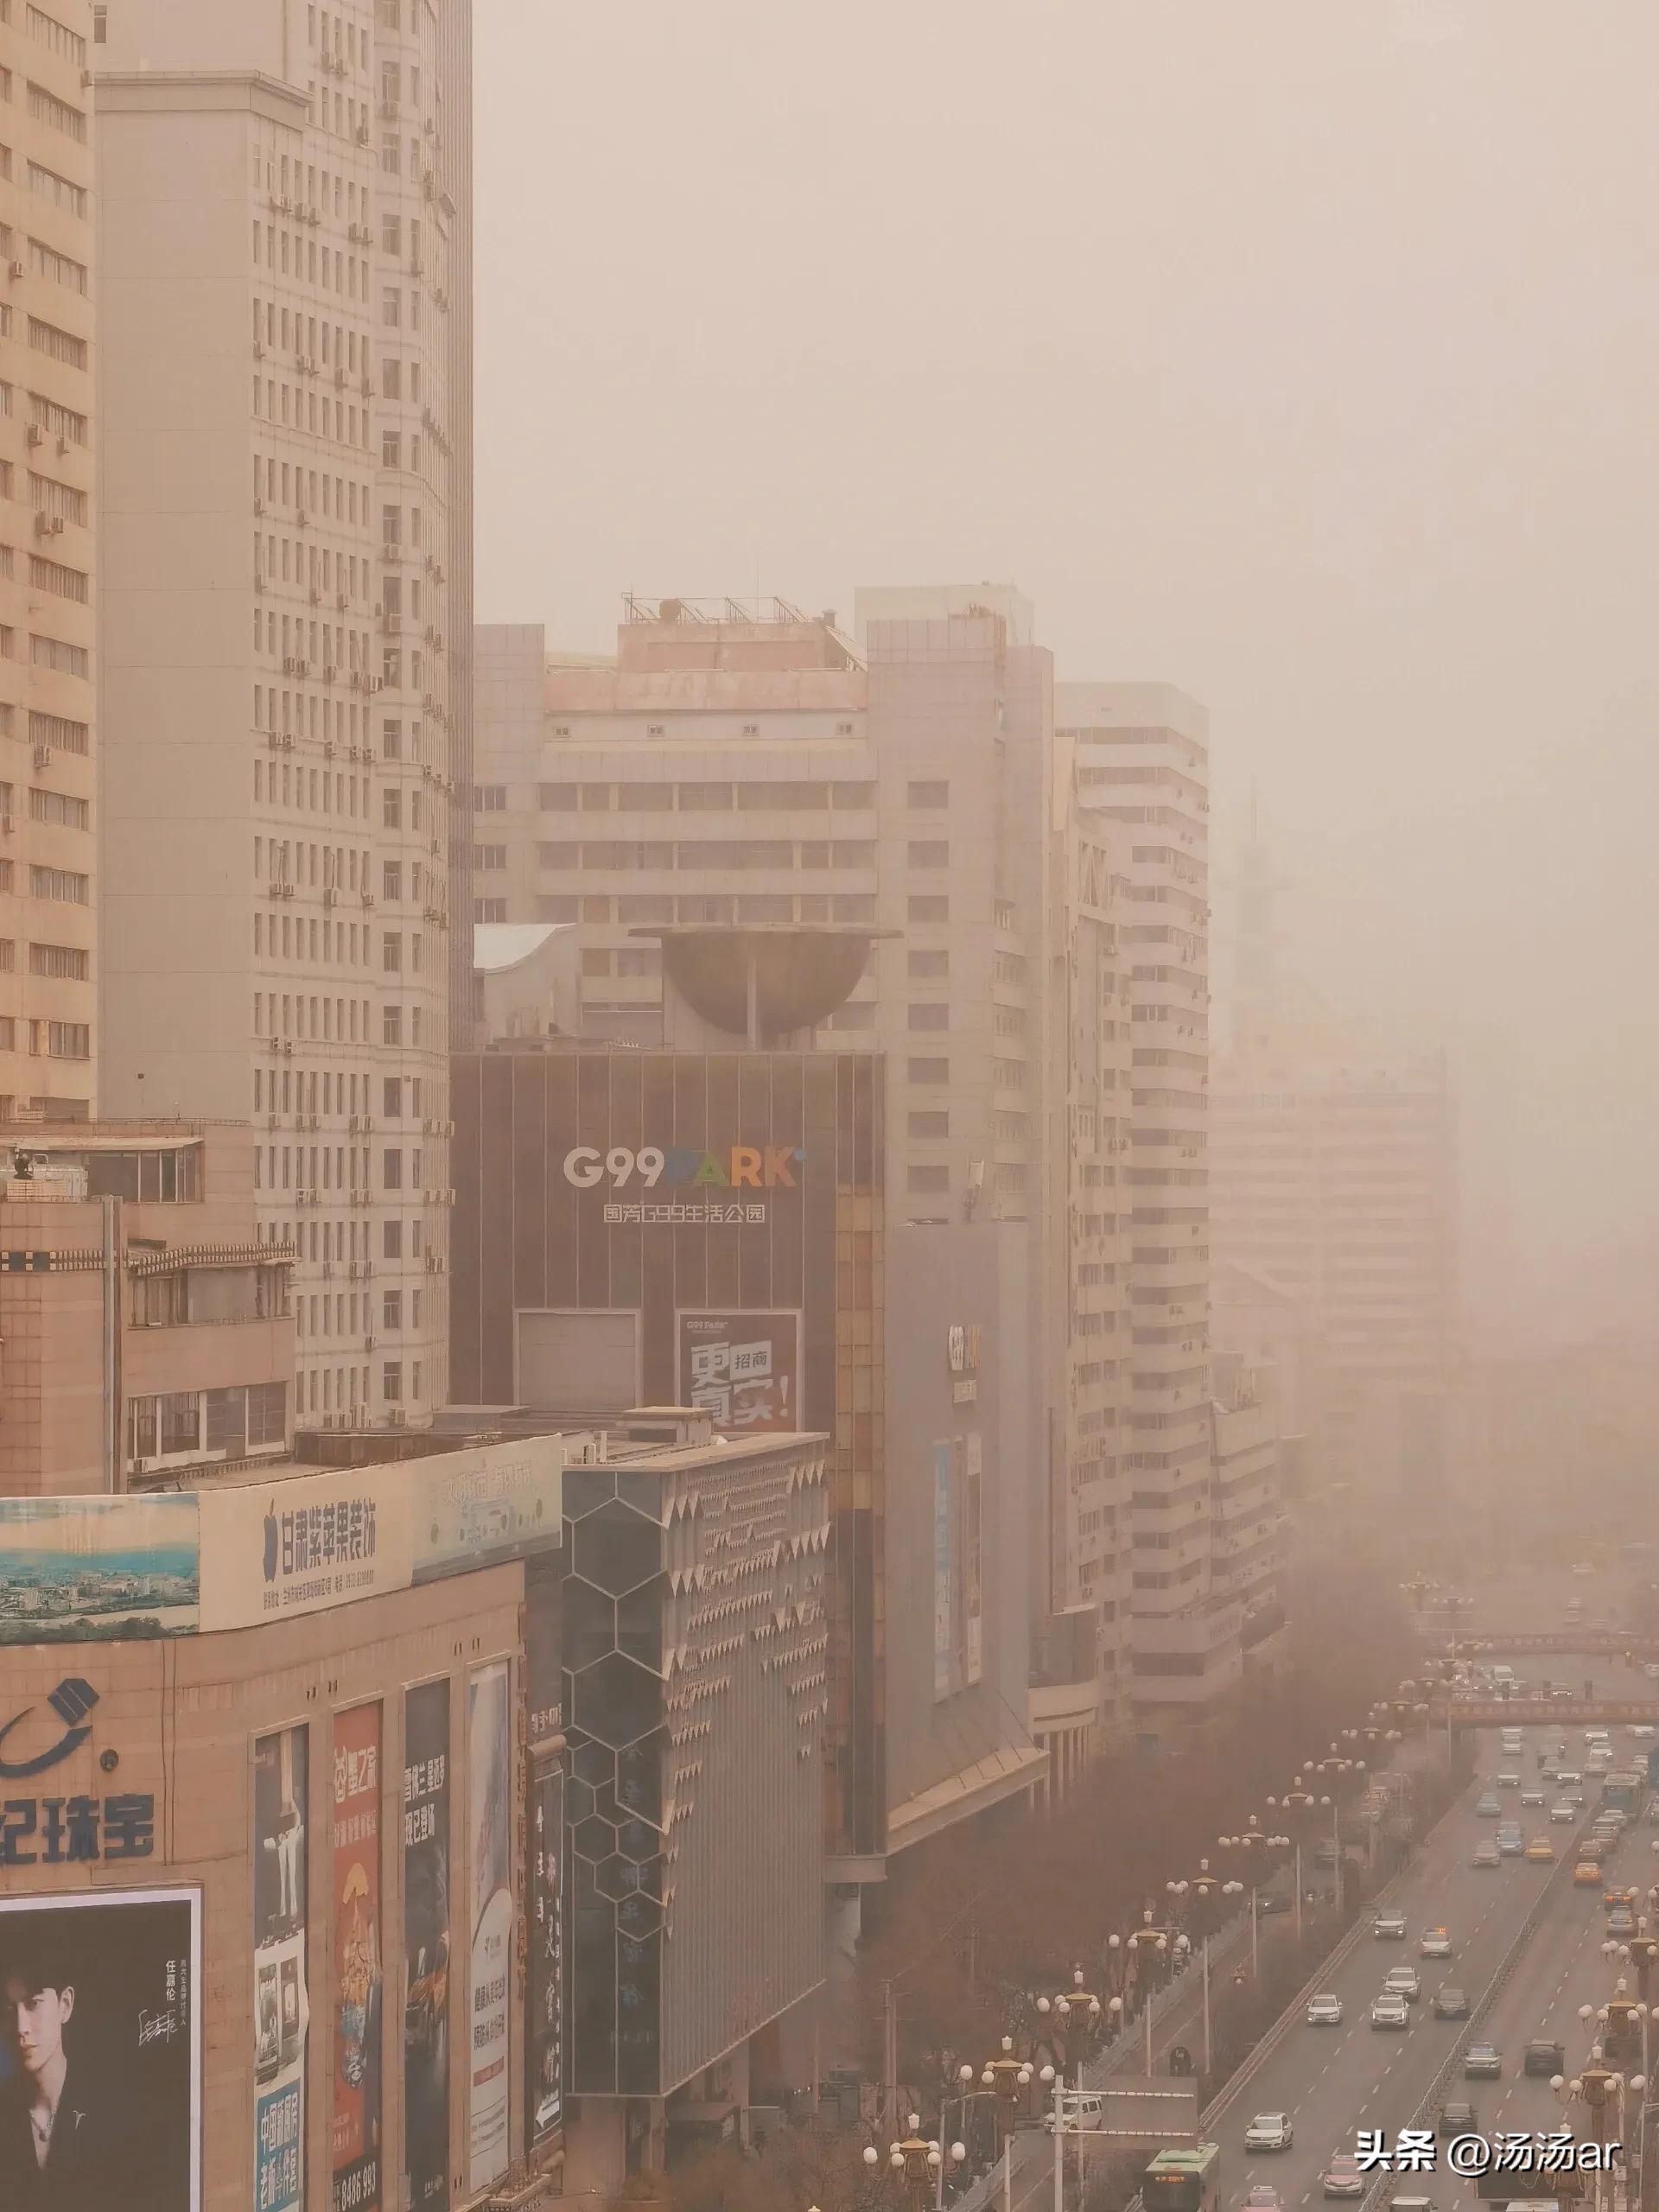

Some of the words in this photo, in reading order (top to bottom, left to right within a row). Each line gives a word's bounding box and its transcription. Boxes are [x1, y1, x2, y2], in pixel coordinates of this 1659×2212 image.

[734, 1351, 768, 1370] 招商
[282, 1496, 376, 1575] 甘肃紫苹果装饰
